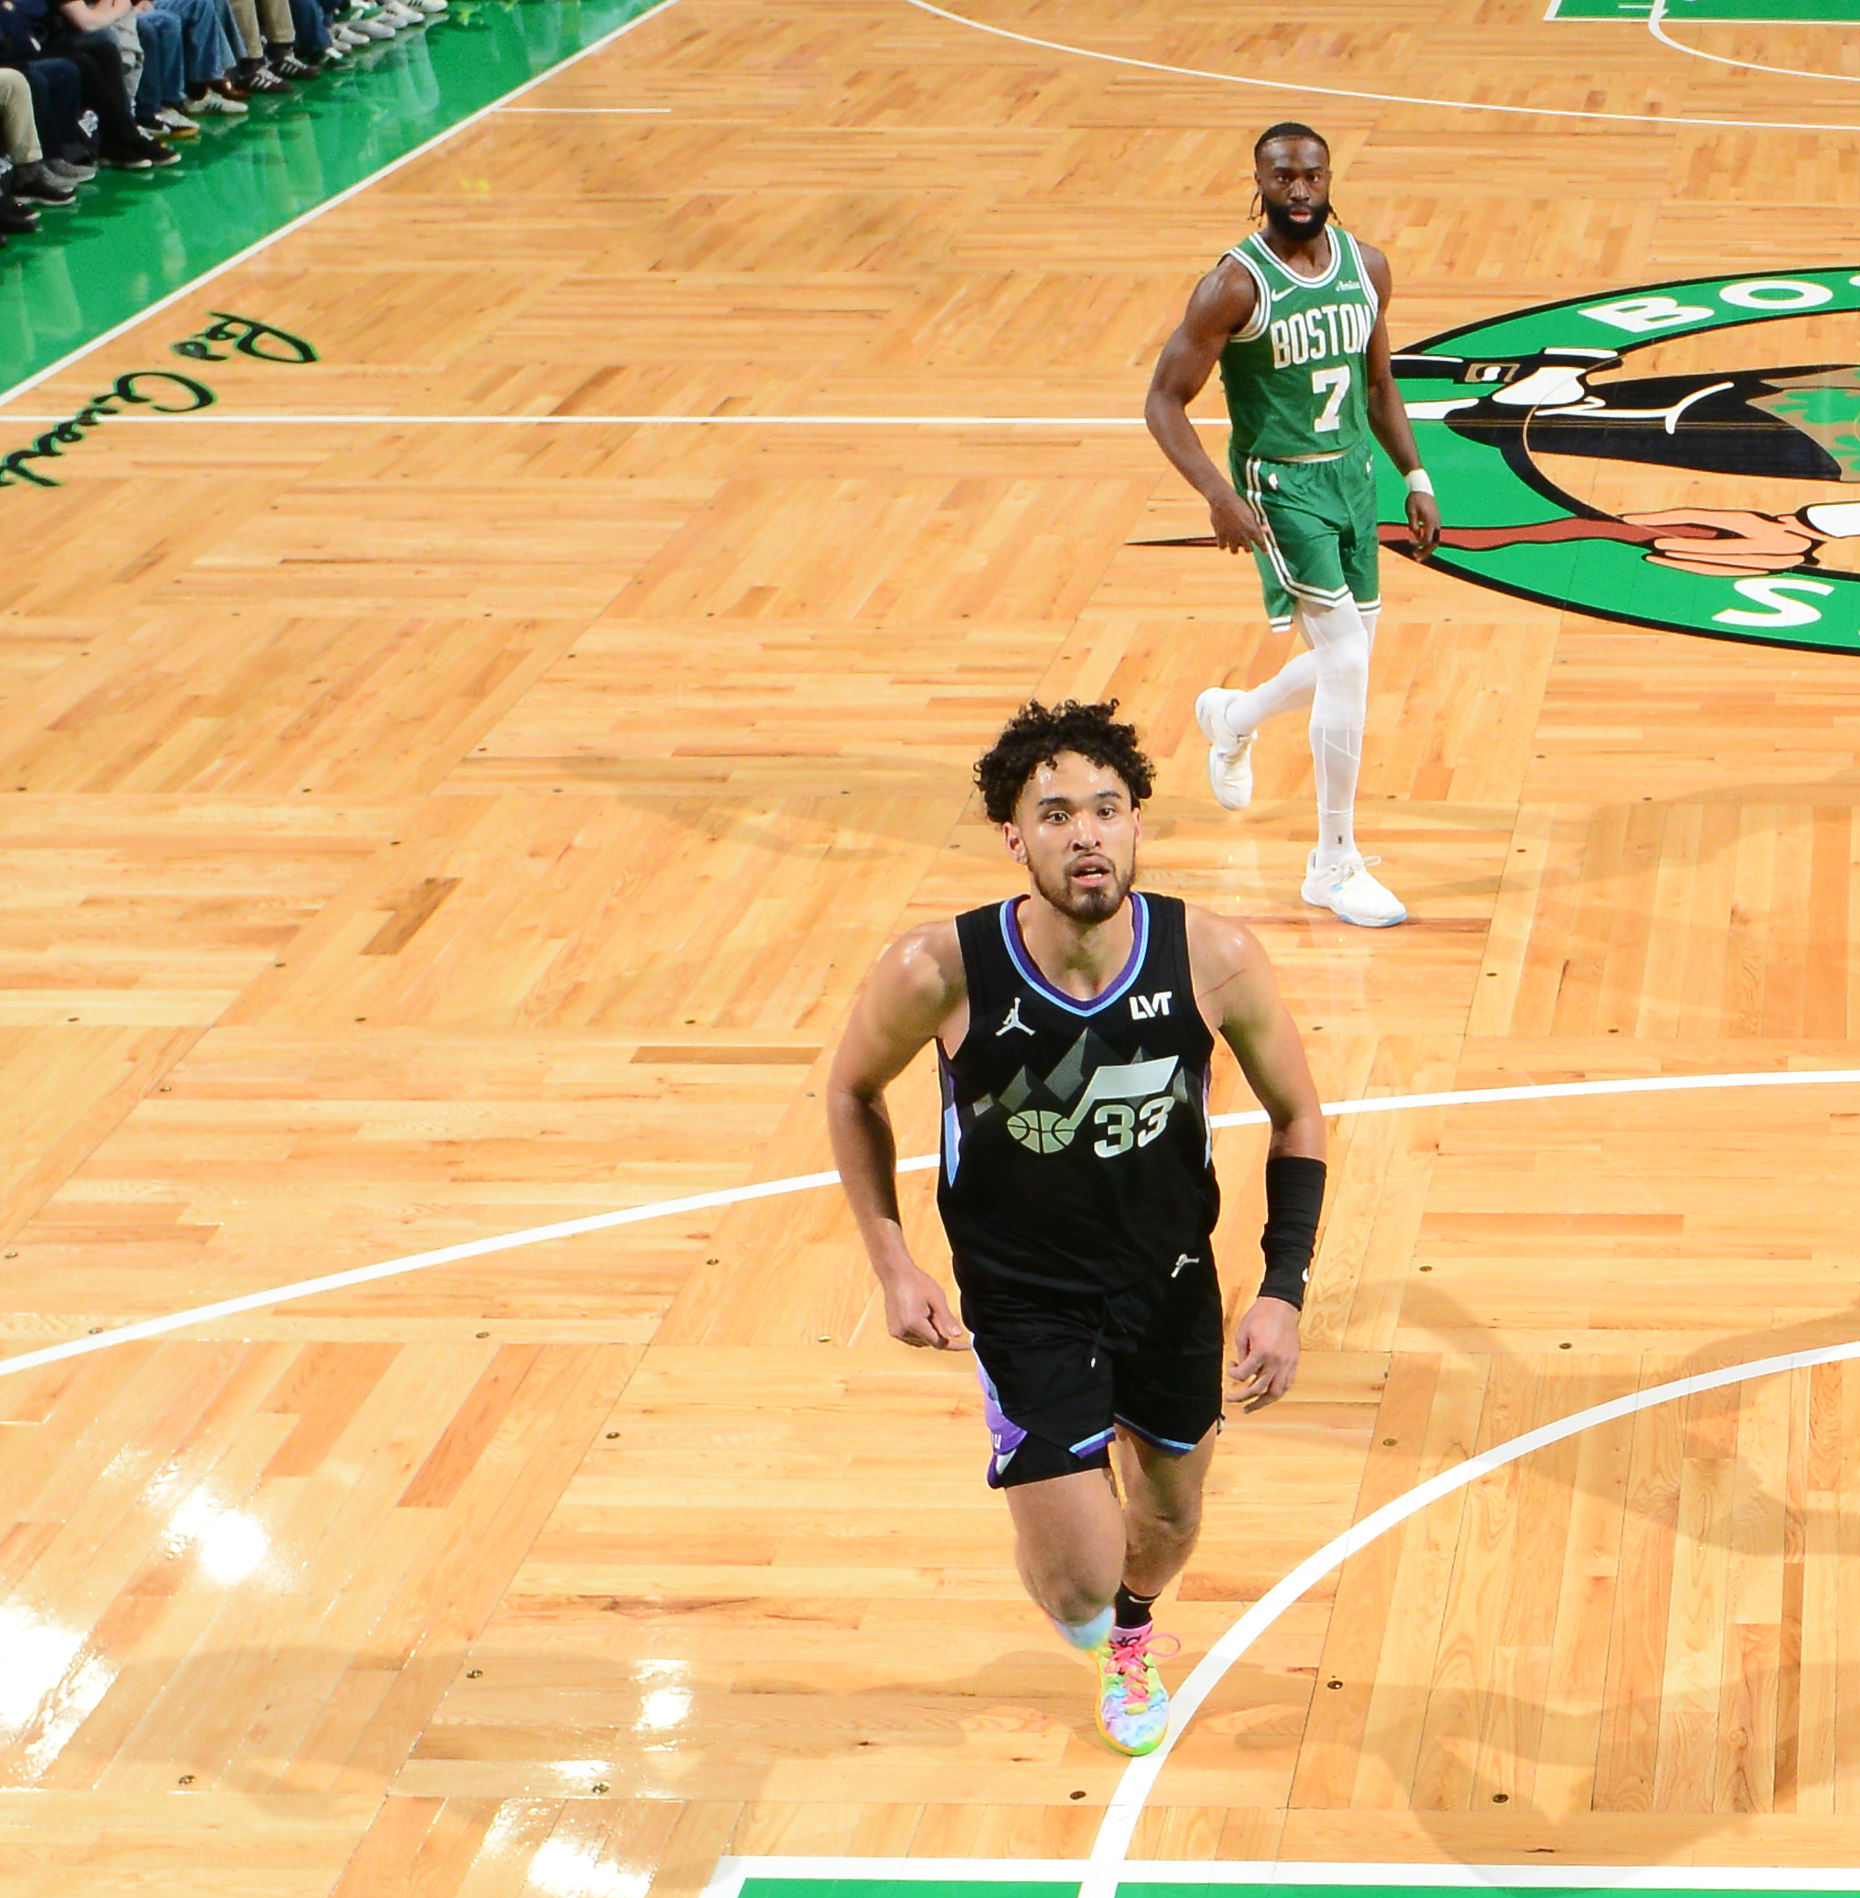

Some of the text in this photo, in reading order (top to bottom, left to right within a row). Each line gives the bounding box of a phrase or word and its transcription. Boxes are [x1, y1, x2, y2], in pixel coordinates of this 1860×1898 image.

[1270, 303, 1373, 370] BOSTON
[1311, 365, 1351, 433] 7
[1128, 991, 1173, 1021] LVT
[1093, 1095, 1176, 1159] 33
